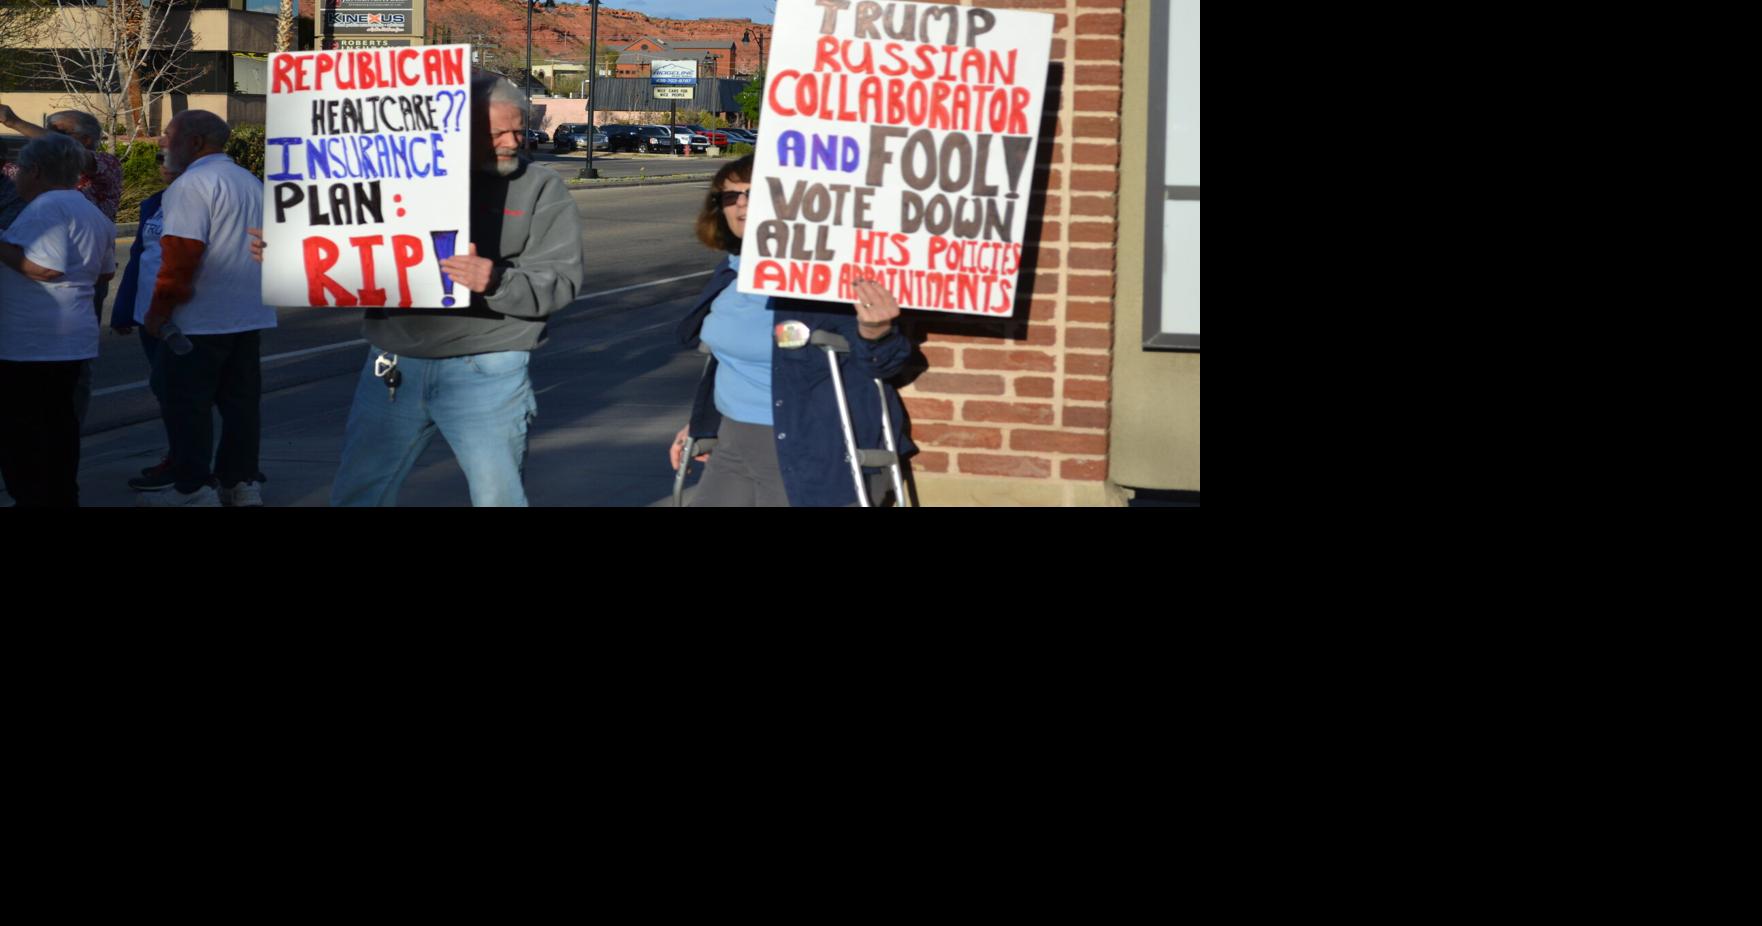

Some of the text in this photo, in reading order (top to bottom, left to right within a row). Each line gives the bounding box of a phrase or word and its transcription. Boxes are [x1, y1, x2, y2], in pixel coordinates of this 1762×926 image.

[328, 12, 405, 23] KINEXUS
[814, 0, 996, 47] TRUMP
[271, 48, 465, 94] REPUBLICAN
[813, 35, 1018, 85] RUSSIAN
[768, 69, 1031, 134] COLLABORATOR
[267, 133, 447, 180] INSURANCE
[777, 125, 1032, 199] AND FOOL!
[765, 177, 1015, 242] VOTE DOWN
[756, 220, 1022, 276] ALL HIS POLICIES
[753, 260, 831, 295] AND
